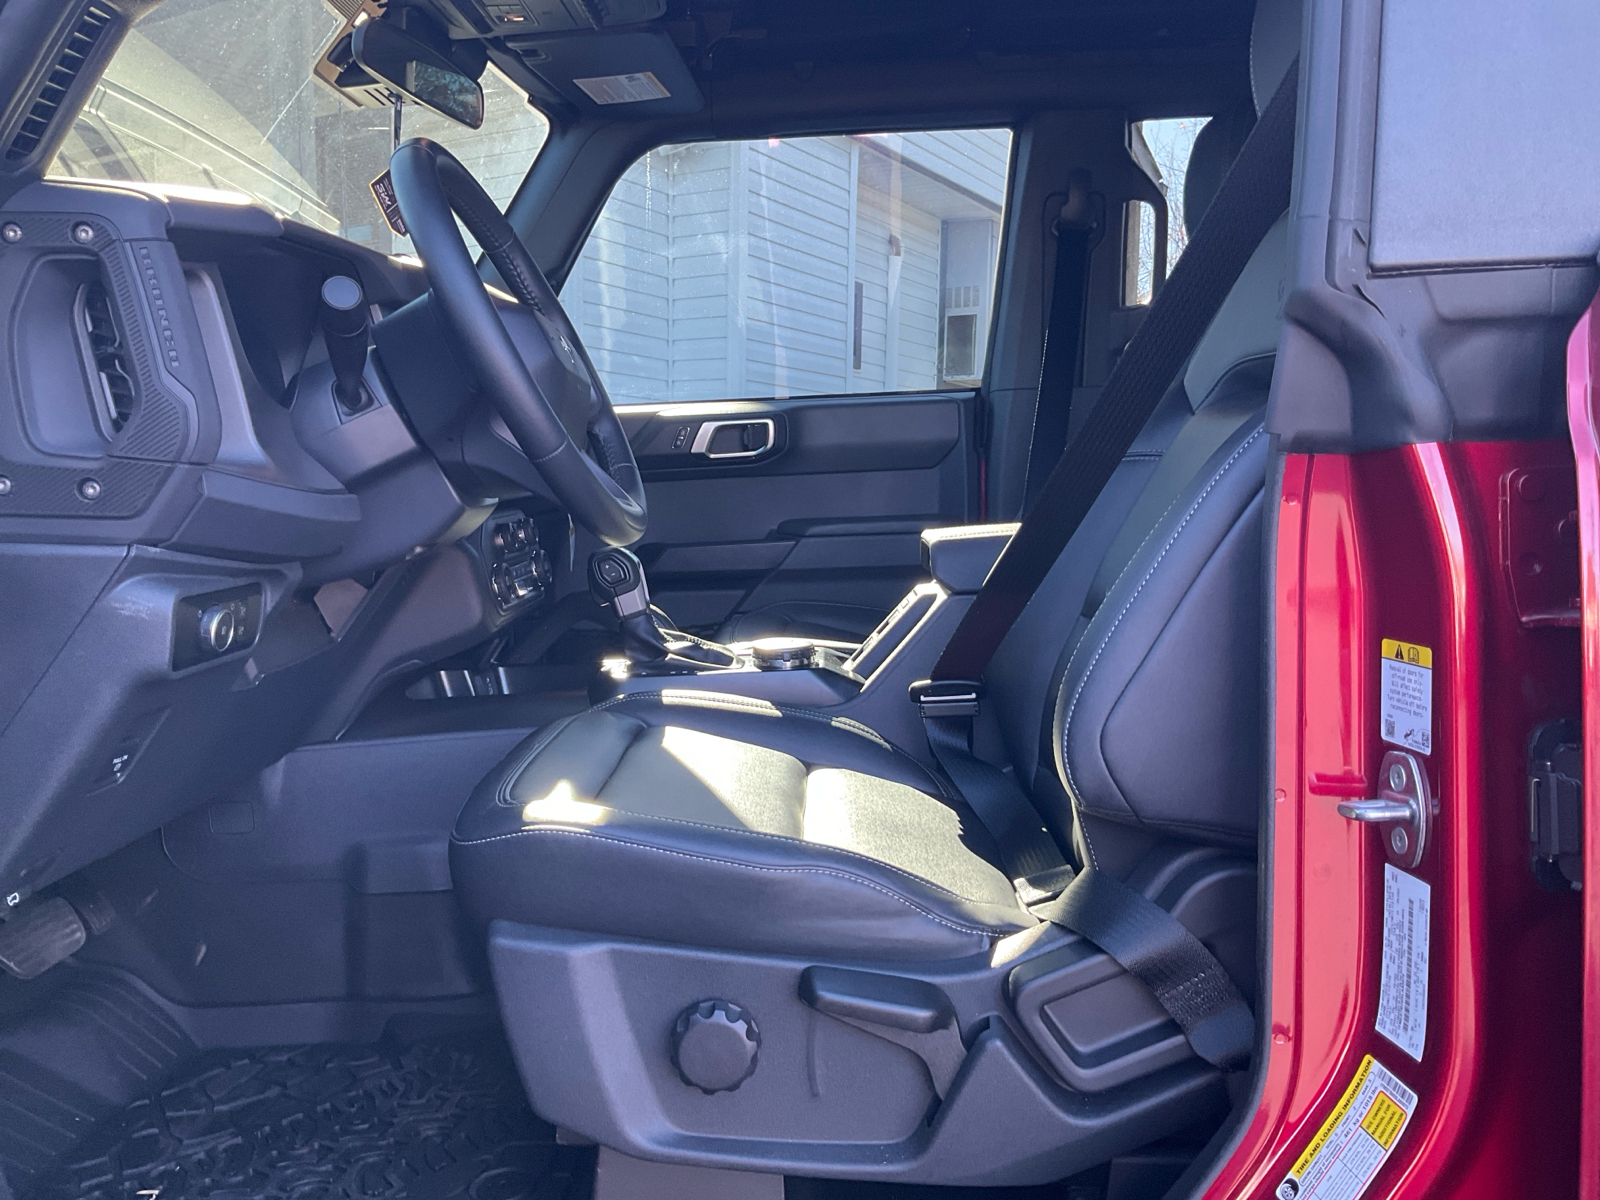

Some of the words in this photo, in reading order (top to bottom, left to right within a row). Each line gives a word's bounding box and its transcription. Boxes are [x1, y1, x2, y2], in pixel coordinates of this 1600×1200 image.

[139, 247, 180, 367] BRONCO
[1296, 1159, 1309, 1174] TIRE
[1309, 1143, 1321, 1158] AND
[1320, 1111, 1343, 1142] LOADING
[1342, 1059, 1372, 1111] INFORMATION
[1353, 1118, 1360, 1127] kg
[1365, 1121, 1373, 1130] SEE
[1371, 1100, 1387, 1120] OWNERS
[1371, 1116, 1386, 1136] MANUAL
[1384, 1104, 1392, 1115] FOR
[1377, 1110, 1399, 1140] ADDITIONAL
[1382, 1112, 1404, 1146] INFORMATION
